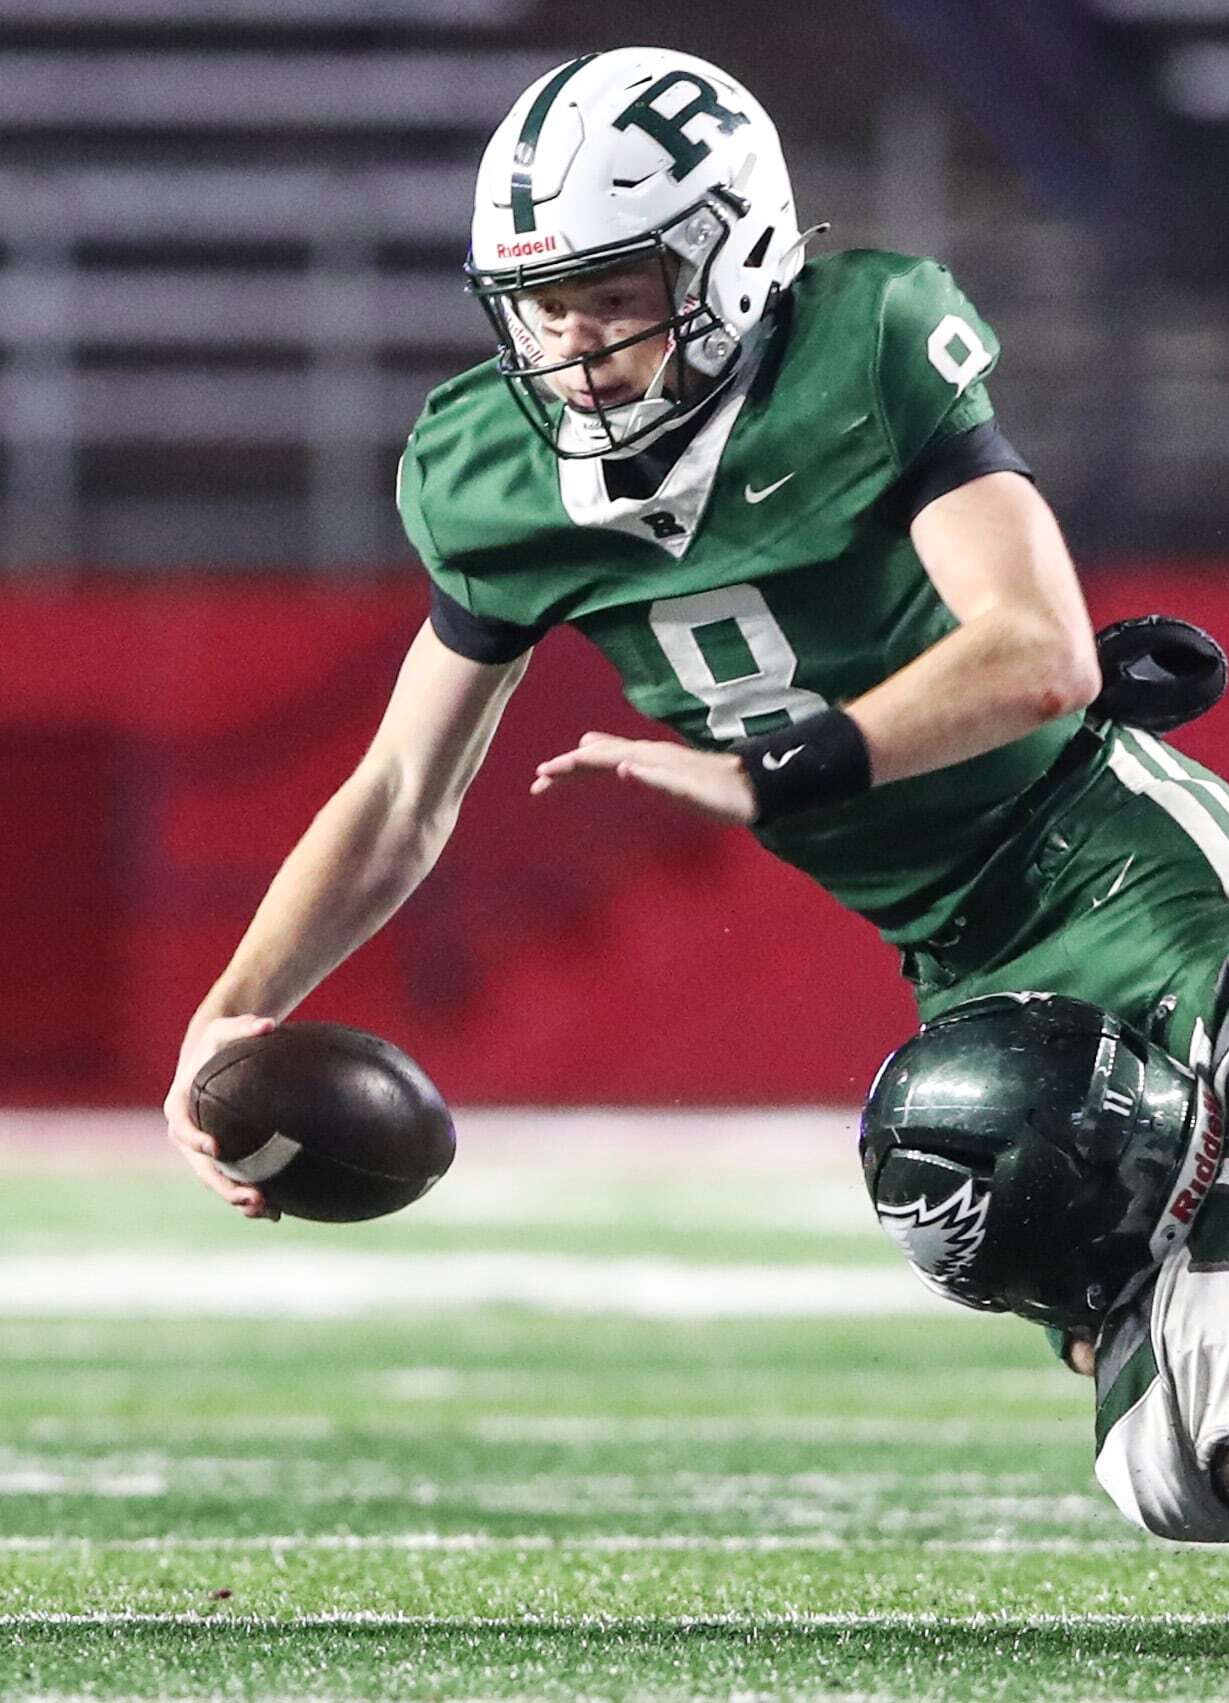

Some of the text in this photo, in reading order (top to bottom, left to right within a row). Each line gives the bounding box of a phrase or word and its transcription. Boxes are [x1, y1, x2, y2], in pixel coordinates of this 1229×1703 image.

[612, 70, 751, 183] R
[496, 235, 557, 259] Riddell
[648, 583, 830, 741] 8
[1102, 1088, 1134, 1118] 11
[1169, 1090, 1225, 1225] Riddell
